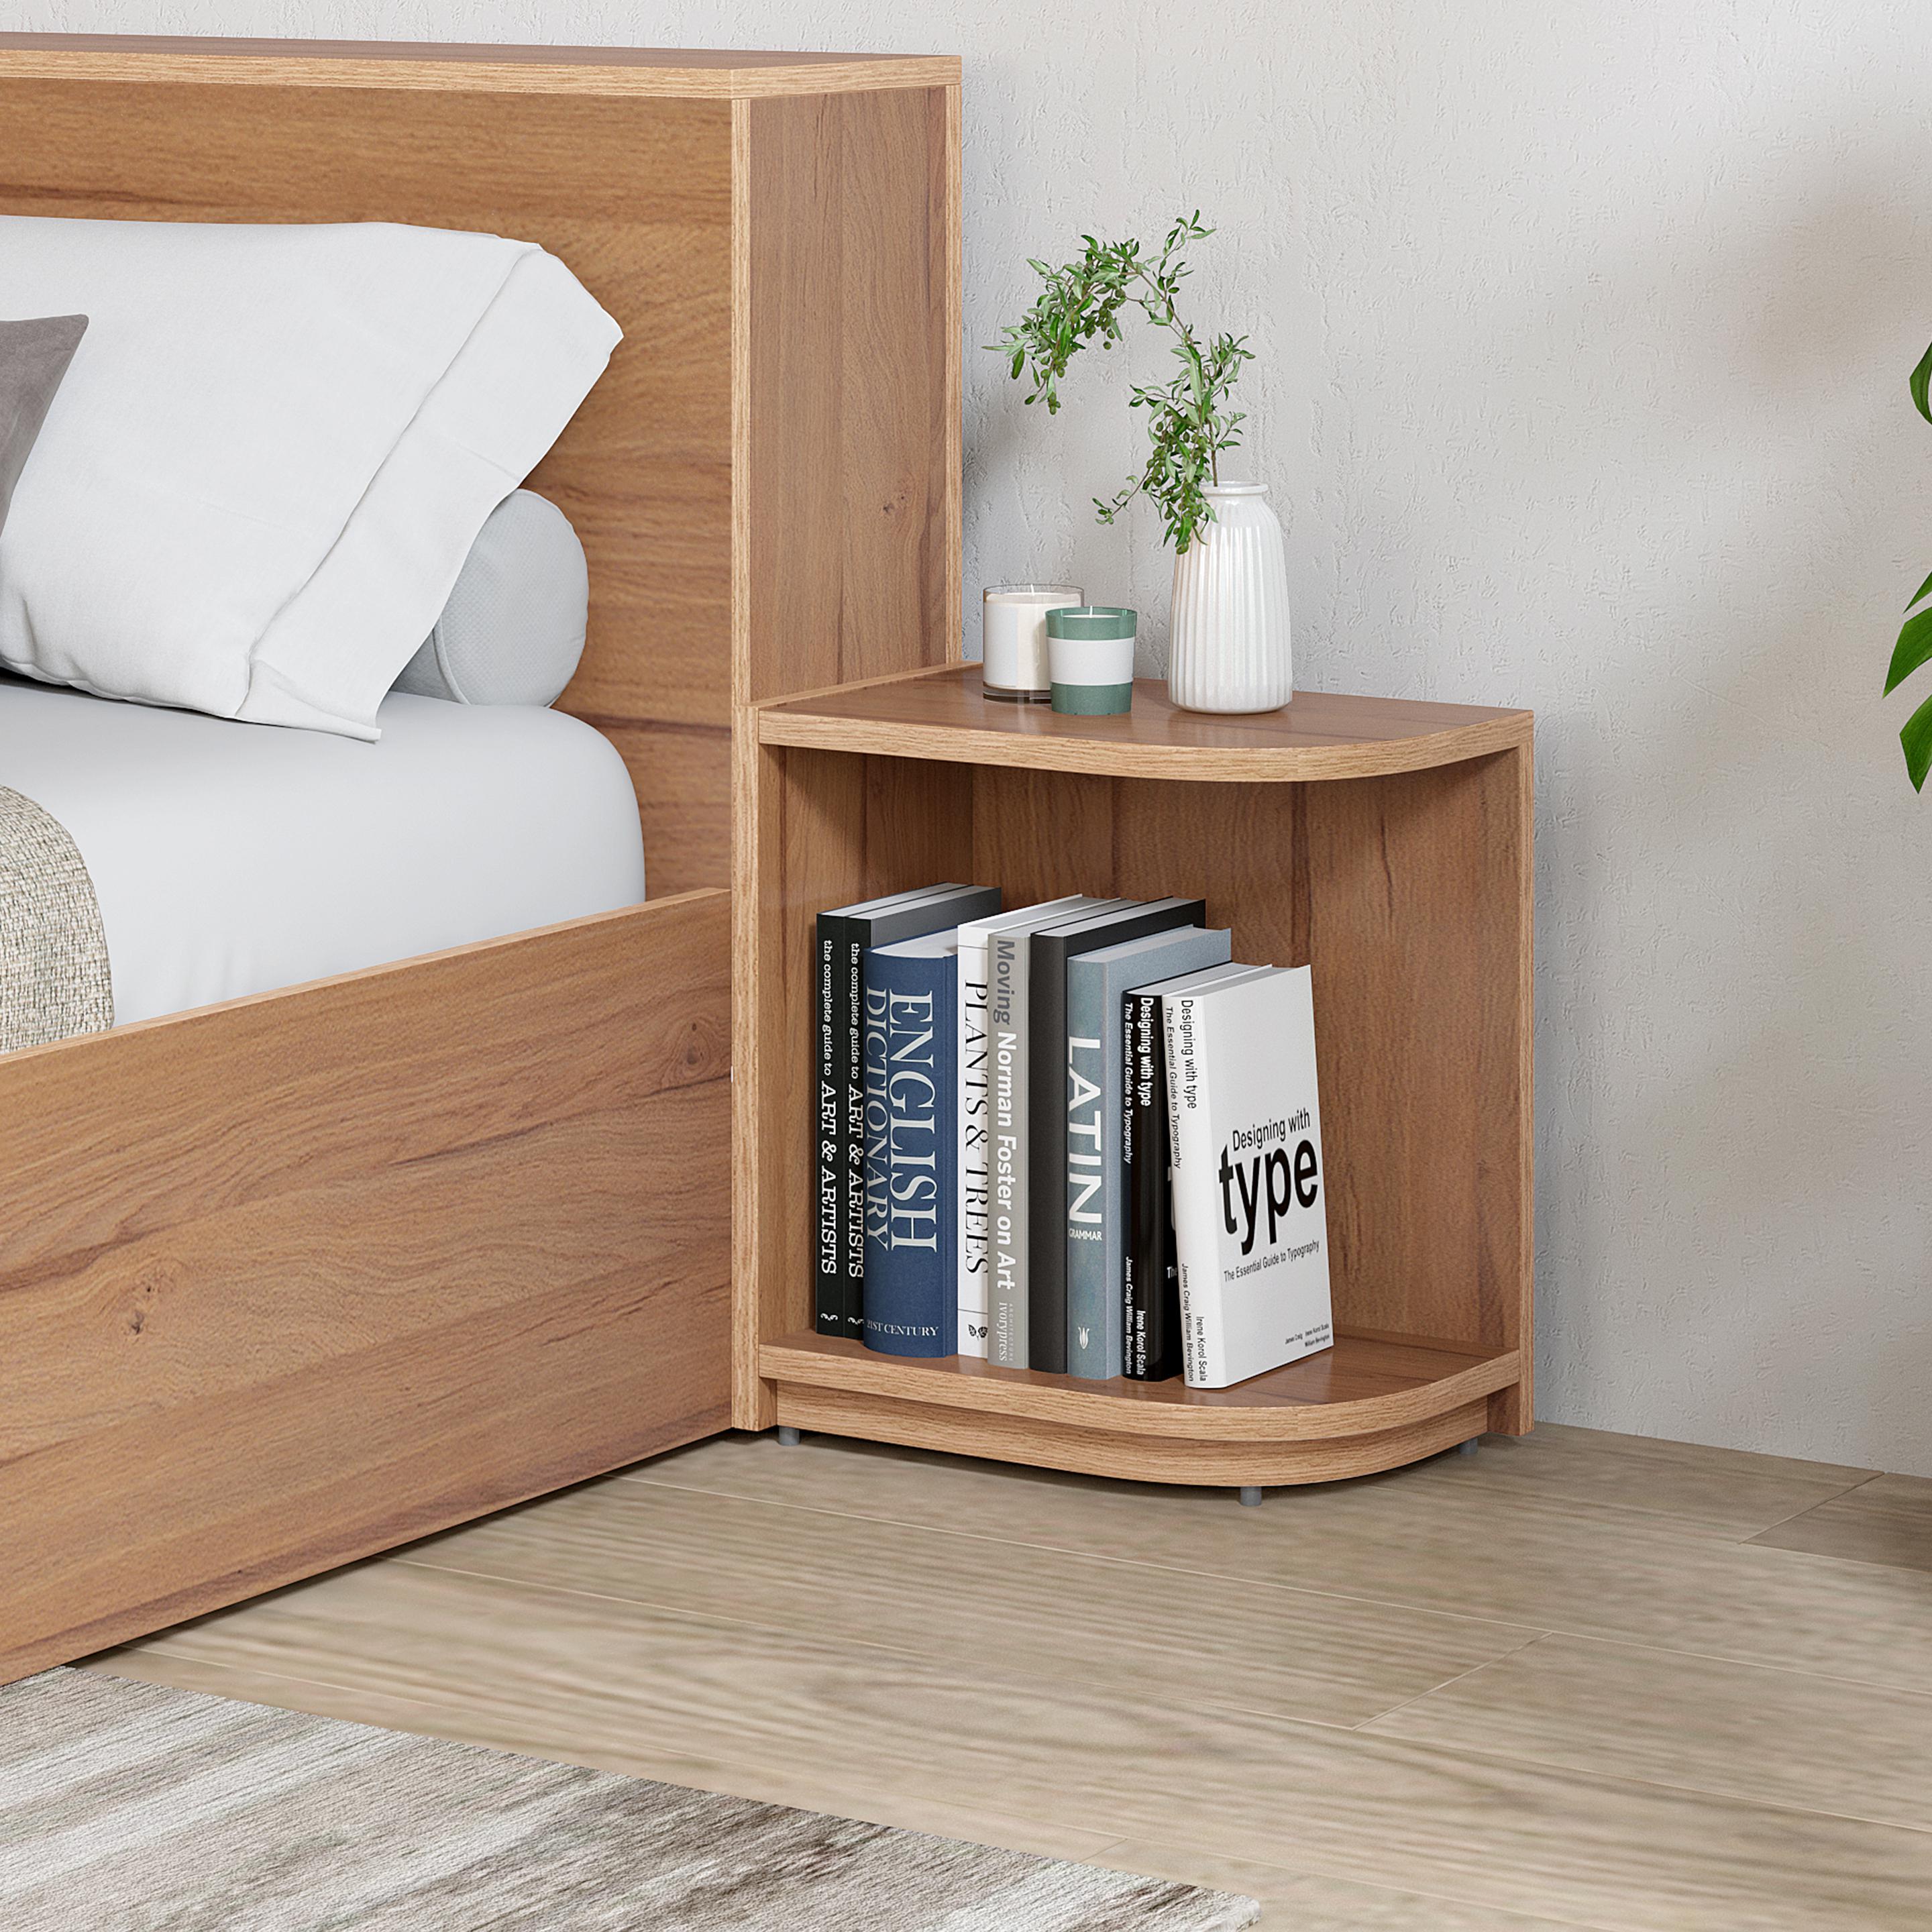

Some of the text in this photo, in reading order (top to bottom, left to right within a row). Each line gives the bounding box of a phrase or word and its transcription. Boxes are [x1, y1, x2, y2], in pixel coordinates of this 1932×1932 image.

[1137, 998, 1154, 1106] Designing with type
[1167, 1027, 1177, 1069] Essential
[1180, 1000, 1197, 1109] Designing with type
[821, 940, 837, 1275] the complete guide to ART & ARTISTS
[849, 943, 863, 1278] the complete guide to ART & ARTISTS
[993, 941, 1017, 1289] Moving Norman Foster on Art
[1124, 1003, 1133, 1164] The Essential Guide to Typography
[1169, 1072, 1178, 1099] Guide
[1171, 1102, 1178, 1111] to
[867, 985, 888, 1250] DICTIONARY
[889, 988, 937, 1252] ENGLISH
[965, 979, 988, 1273] PLANTS & TREES
[1069, 1036, 1102, 1224] LATIN
[1171, 1114, 1182, 1169] Typography
[1232, 1108, 1310, 1151] Designing with
[1219, 1139, 1318, 1256] type
[1069, 1228, 1102, 1240] GRAMMAR
[1224, 1240, 1320, 1282] The Essential Guide to Typography
[1125, 1283, 1133, 1304] Craig
[884, 1324, 938, 1336] CENTURY
[996, 1302, 1007, 1361] ivorypress
[1124, 1335, 1133, 1374] Bevington
[1136, 1310, 1146, 1375] Irene Korol Scala
[1187, 1343, 1195, 1381] Bevington
[1196, 1316, 1208, 1381] Irene Korol Scala
